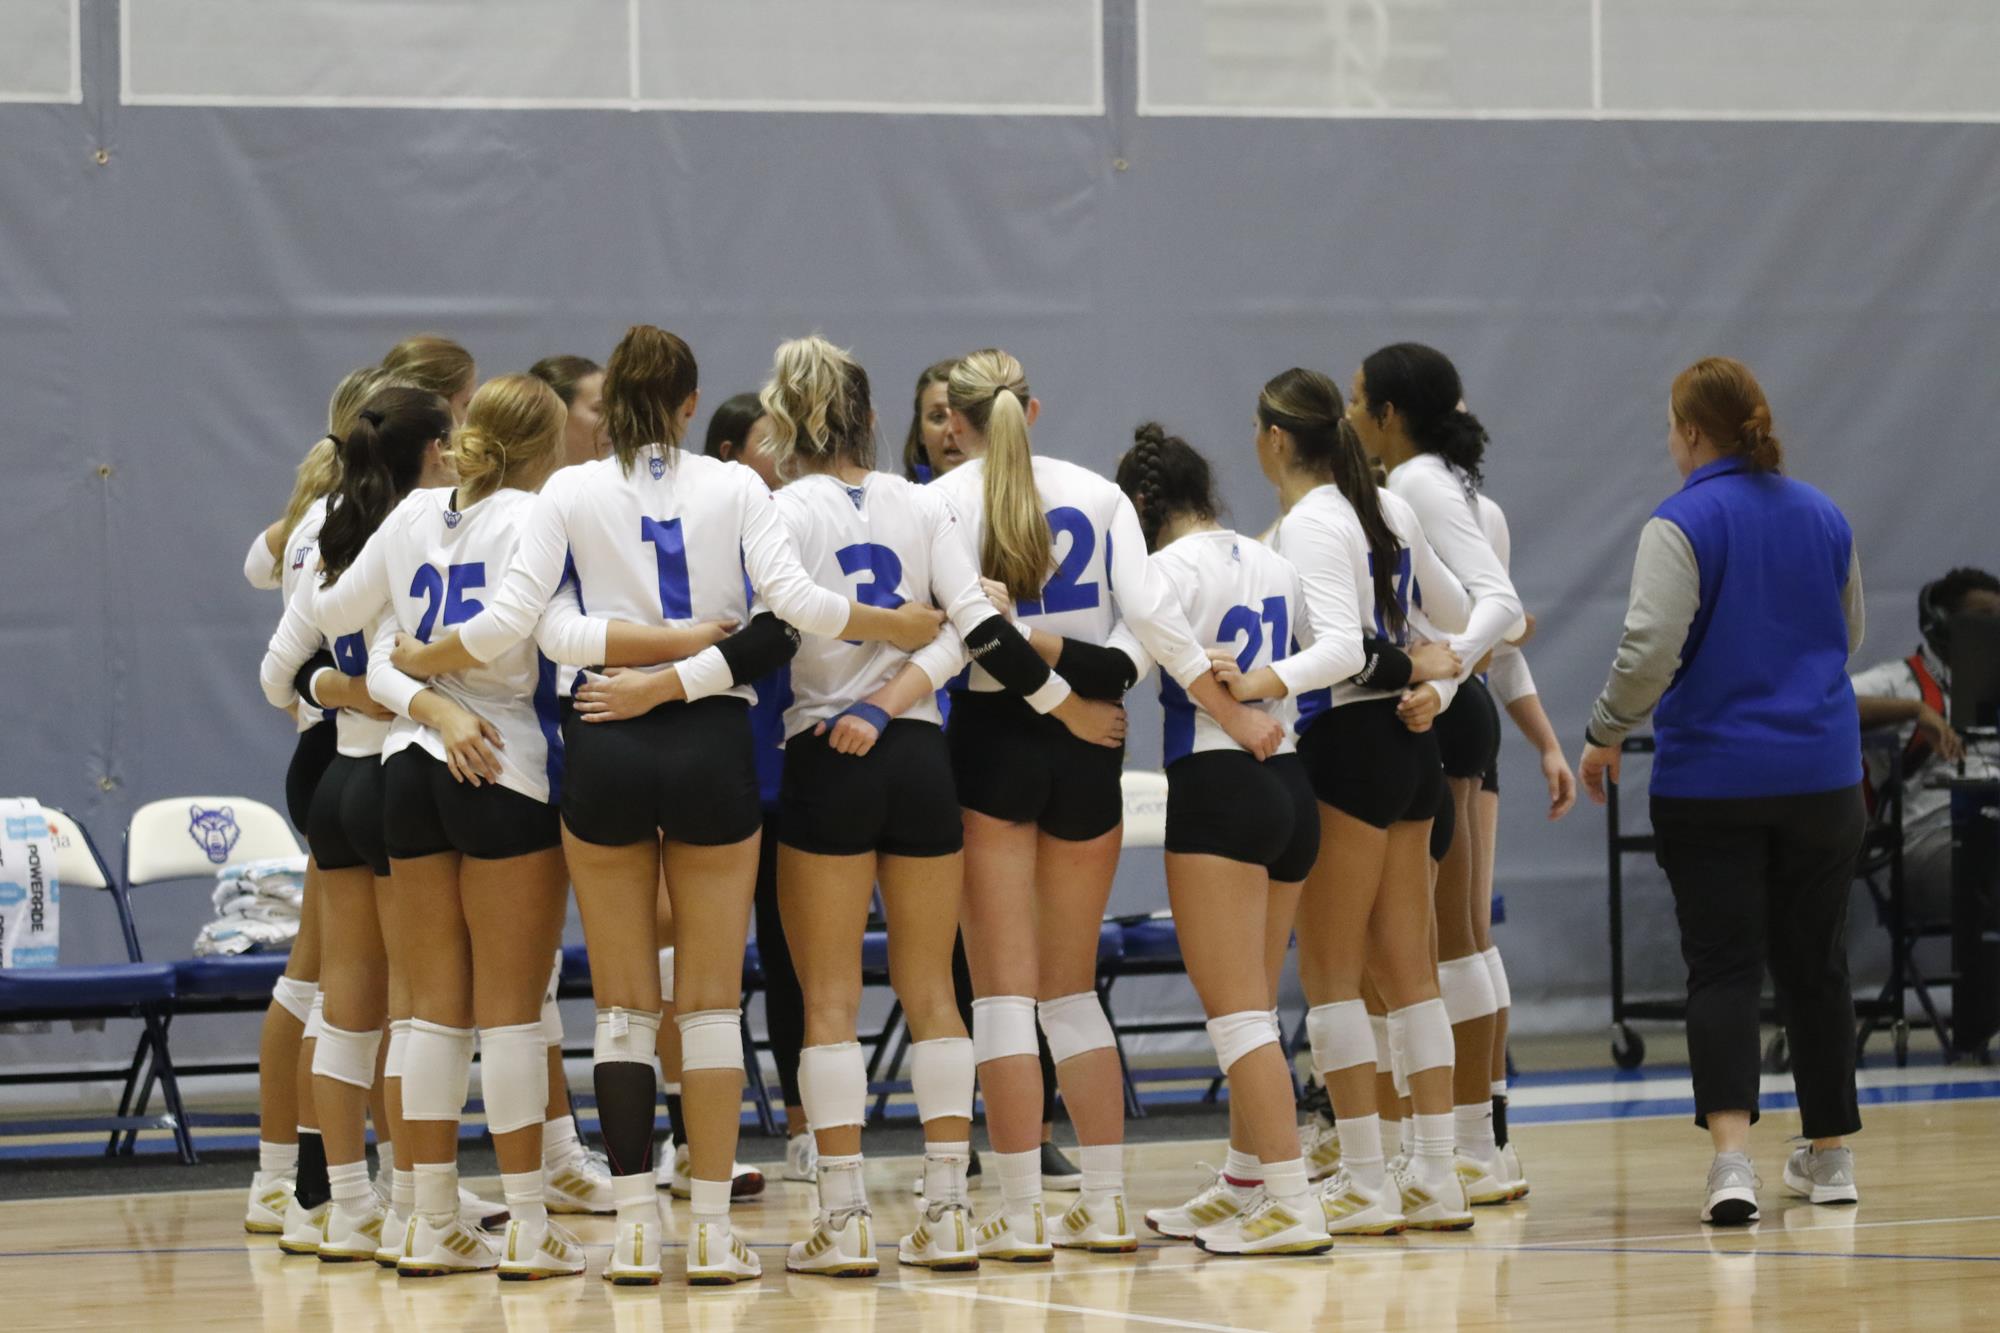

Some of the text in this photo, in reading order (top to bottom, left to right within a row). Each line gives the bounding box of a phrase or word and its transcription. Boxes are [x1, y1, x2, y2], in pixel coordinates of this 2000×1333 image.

[409, 563, 486, 645] 25
[641, 516, 693, 620] 1
[835, 543, 906, 646] 3
[1016, 506, 1100, 617] 2
[1216, 595, 1288, 704] 21
